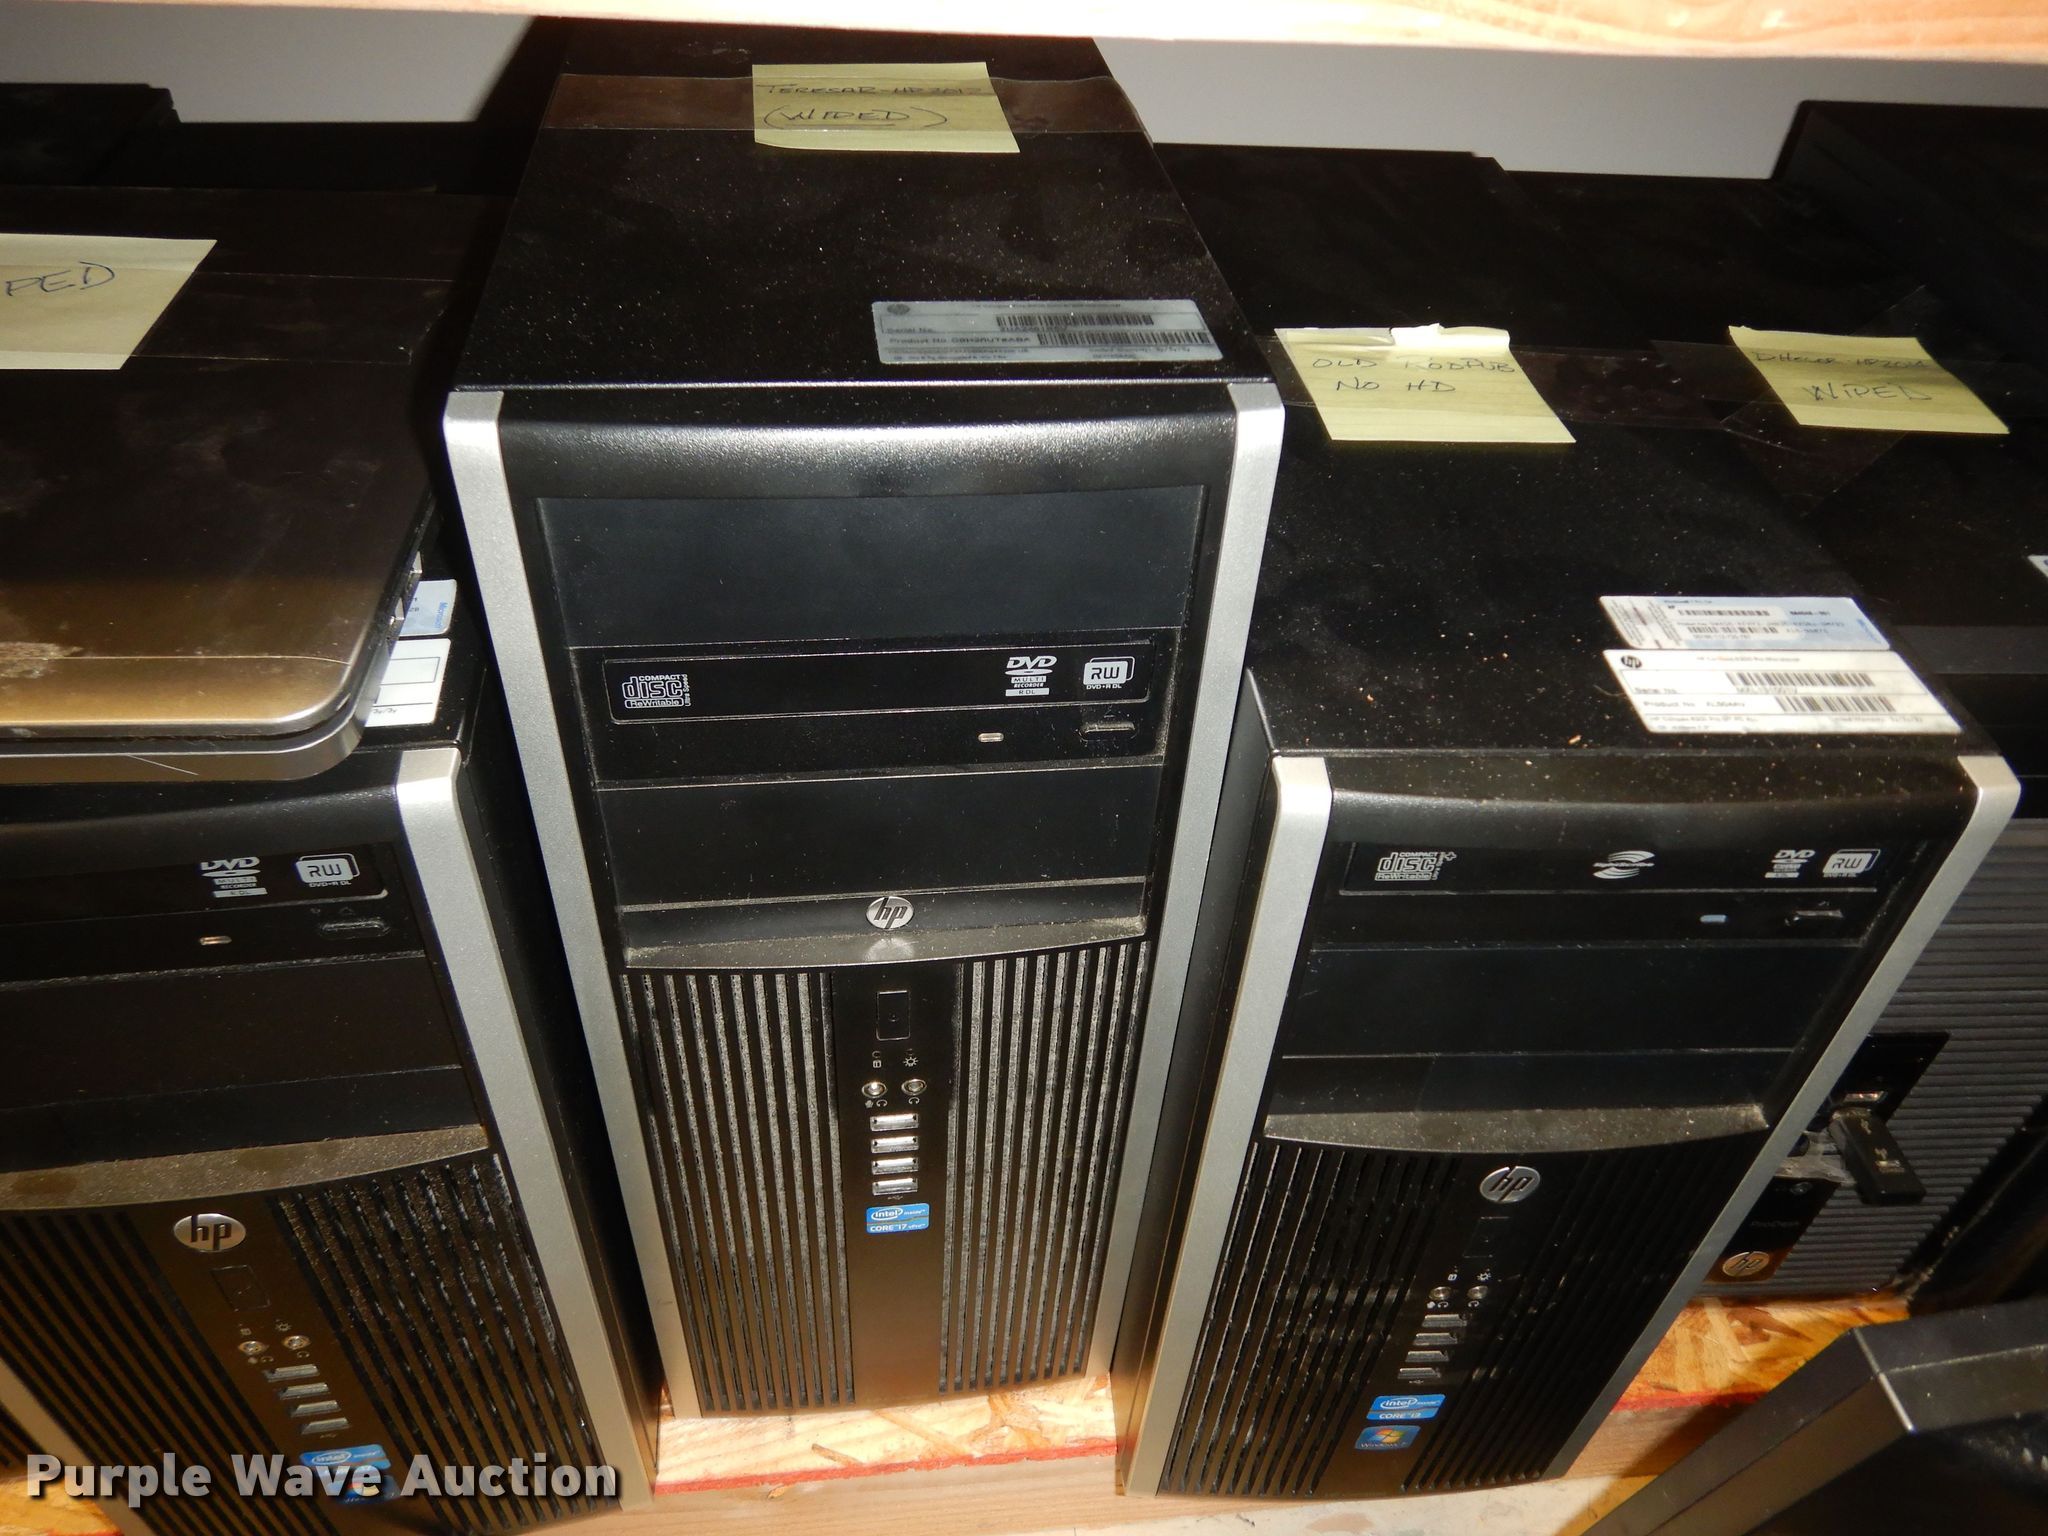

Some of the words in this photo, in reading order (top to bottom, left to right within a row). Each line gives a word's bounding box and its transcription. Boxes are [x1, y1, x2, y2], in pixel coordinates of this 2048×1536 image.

[1311, 358, 1378, 369] OLD
[1406, 379, 1457, 393] HD
[1006, 655, 1058, 669] DVD
[1091, 667, 1120, 680] RW
[621, 676, 684, 700] disc
[628, 699, 682, 708] ReWritable
[1774, 850, 1816, 859] DVD
[200, 856, 261, 871] DVD
[1376, 852, 1437, 873] disc
[1831, 857, 1862, 869] RW
[307, 864, 343, 878] RW
[872, 897, 909, 929] hp
[1488, 1167, 1534, 1201] hp
[189, 1215, 233, 1250] hp
